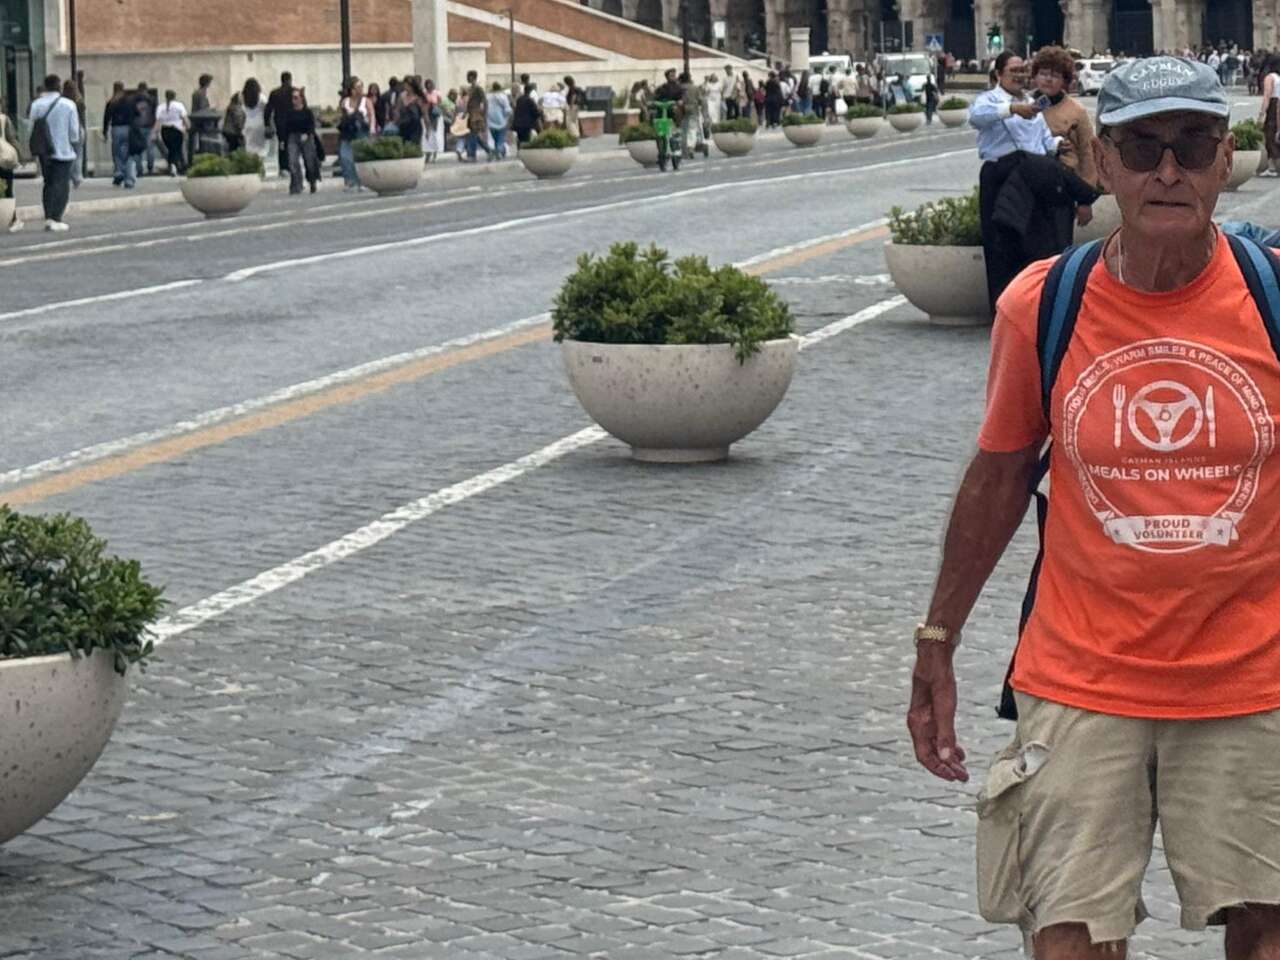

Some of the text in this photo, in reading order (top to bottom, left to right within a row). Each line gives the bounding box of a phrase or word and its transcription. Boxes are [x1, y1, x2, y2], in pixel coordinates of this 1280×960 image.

[1130, 62, 1195, 81] CAYMAN
[1142, 77, 1186, 89] RUGBY
[1113, 348, 1147, 365] WARM
[1147, 345, 1186, 357] SMILES
[1188, 348, 1197, 359] &
[1198, 351, 1233, 377] PEACE
[1230, 372, 1245, 386] OF
[1241, 385, 1261, 410] MIND
[1254, 411, 1267, 425] TO
[1088, 464, 1243, 481] MEALS ON WHEELS
[1144, 519, 1190, 529] PROUD
[1133, 530, 1204, 539] VOLUNTEER
